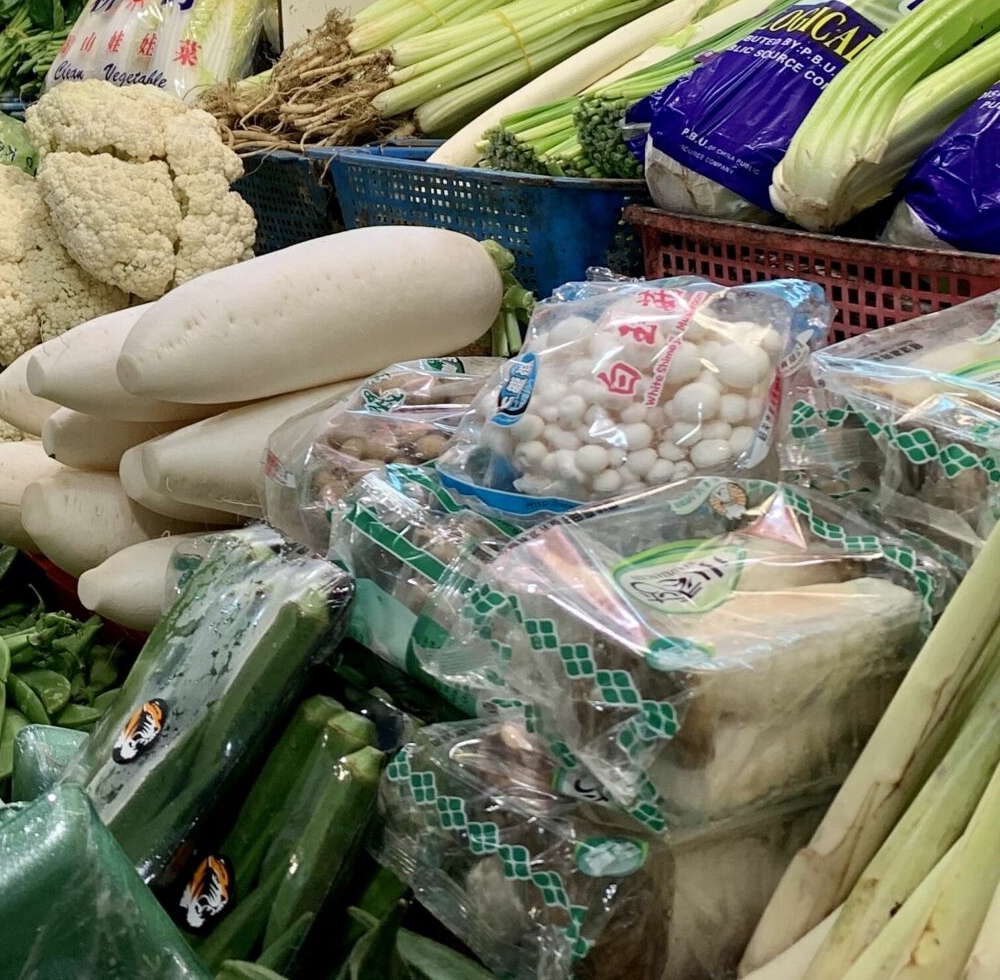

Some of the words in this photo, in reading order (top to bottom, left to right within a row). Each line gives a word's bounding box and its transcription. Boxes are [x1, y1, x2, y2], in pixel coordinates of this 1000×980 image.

[53, 60, 85, 81] Clean
[103, 63, 169, 88] Vegetable
[753, 48, 805, 73] SOURCE
[645, 374, 665, 407] White
